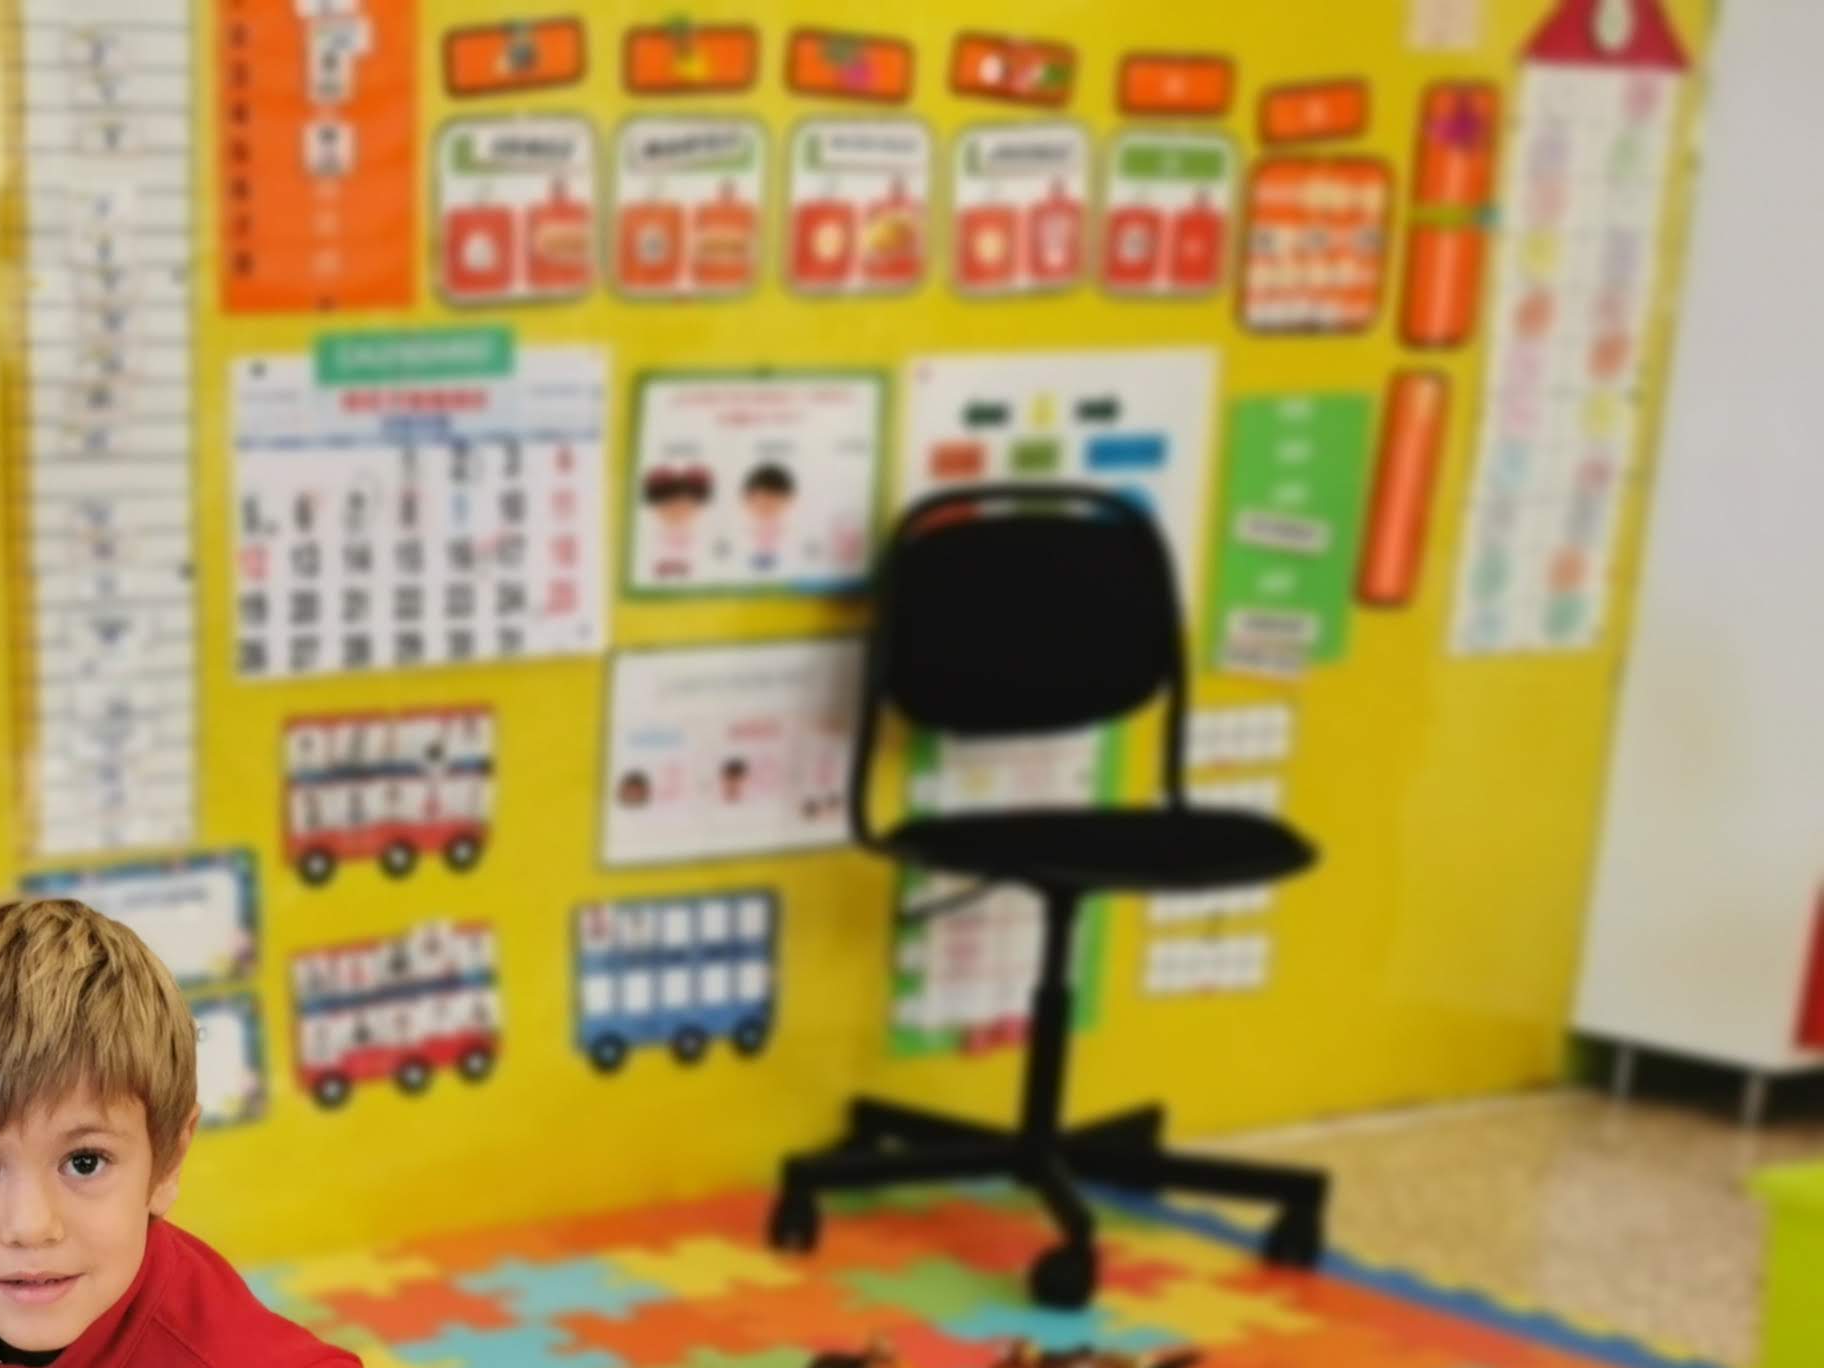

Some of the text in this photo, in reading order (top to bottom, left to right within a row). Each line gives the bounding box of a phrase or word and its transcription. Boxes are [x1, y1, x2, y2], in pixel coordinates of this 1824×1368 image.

[289, 542, 320, 578] 13
[342, 540, 372, 575] 14
[395, 537, 424, 573] 15
[447, 537, 475, 572] 16
[495, 532, 528, 566] 17
[495, 580, 527, 615] 24
[289, 633, 319, 670] 27
